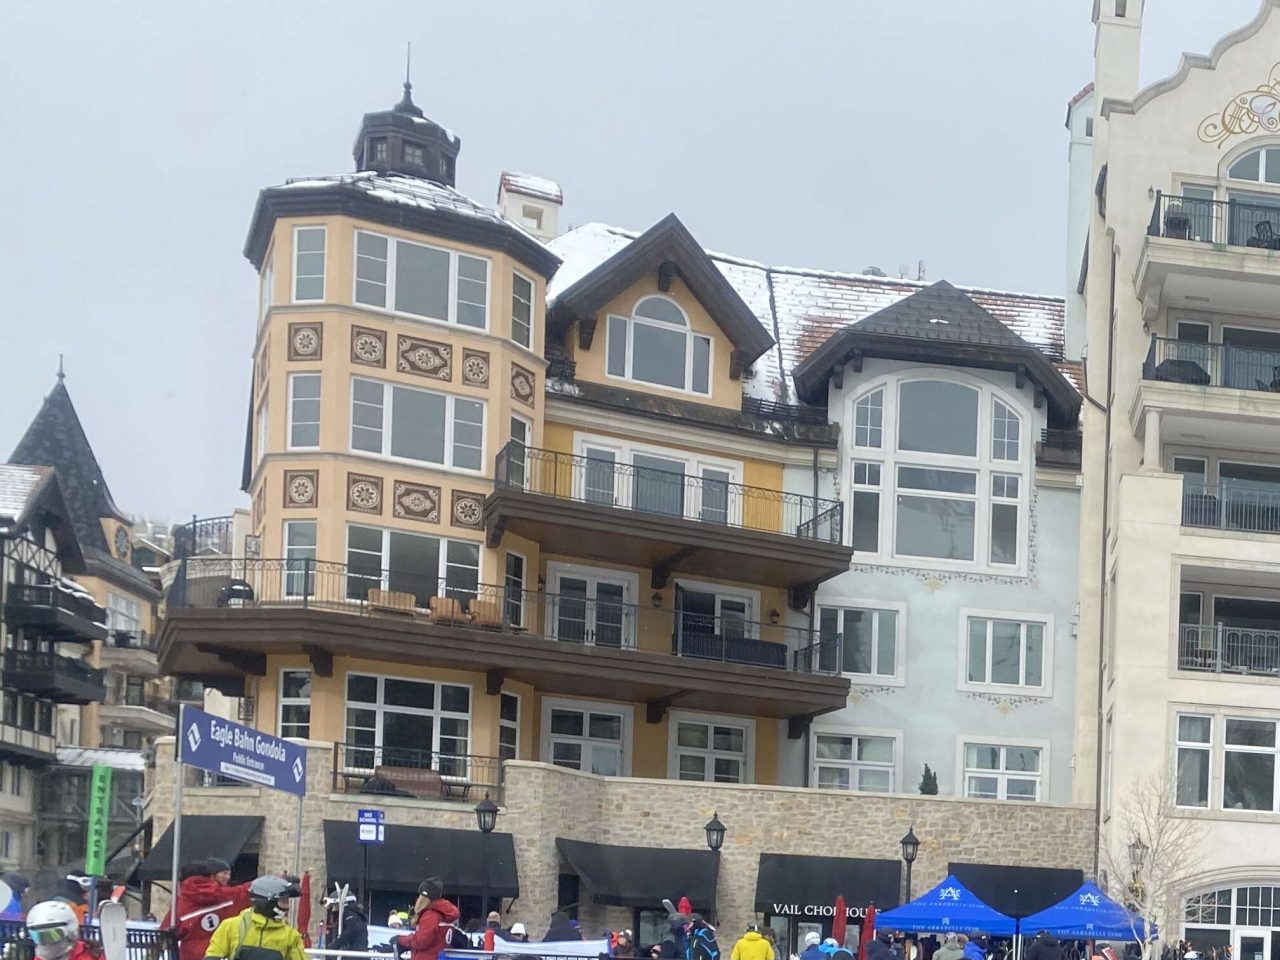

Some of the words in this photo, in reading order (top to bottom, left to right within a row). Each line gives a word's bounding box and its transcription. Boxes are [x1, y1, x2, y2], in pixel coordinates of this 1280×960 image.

[210, 720, 233, 748] Eagle
[234, 728, 255, 751] Bahn
[256, 735, 286, 762] Gondola
[94, 774, 106, 860] ENTRANCE
[773, 903, 802, 915] VAIL
[804, 905, 882, 918] CHOOU
